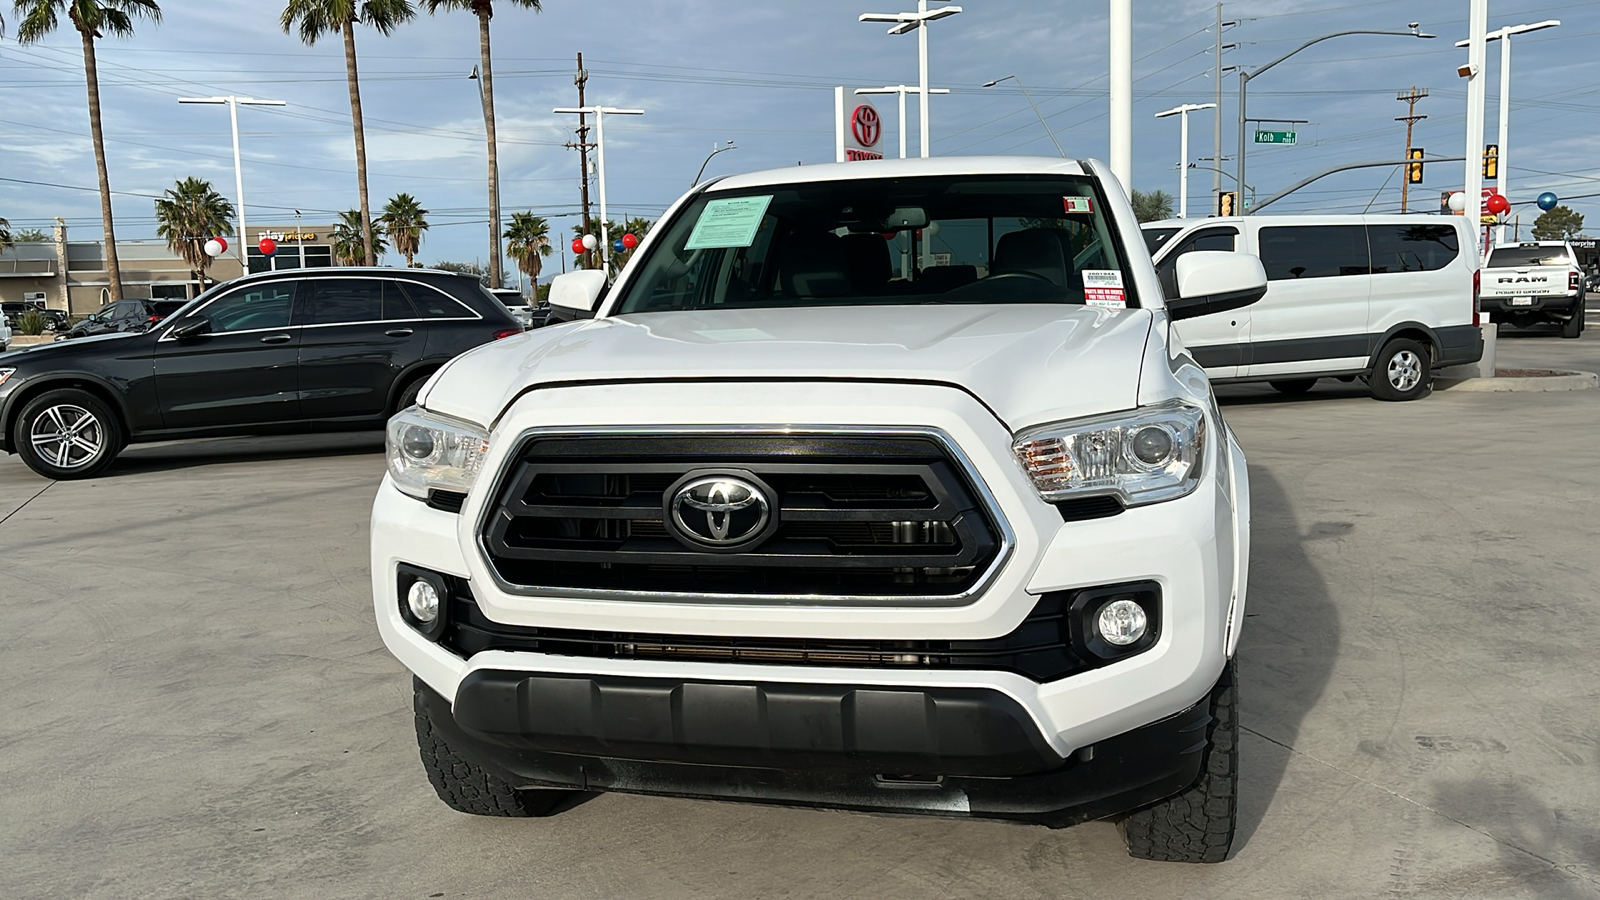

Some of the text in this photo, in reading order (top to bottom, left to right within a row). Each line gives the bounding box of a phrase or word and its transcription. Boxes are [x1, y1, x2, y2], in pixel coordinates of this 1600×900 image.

[1259, 132, 1274, 142] Kolb
[1569, 240, 1596, 248] nterprise
[1498, 276, 1548, 284] RAM
